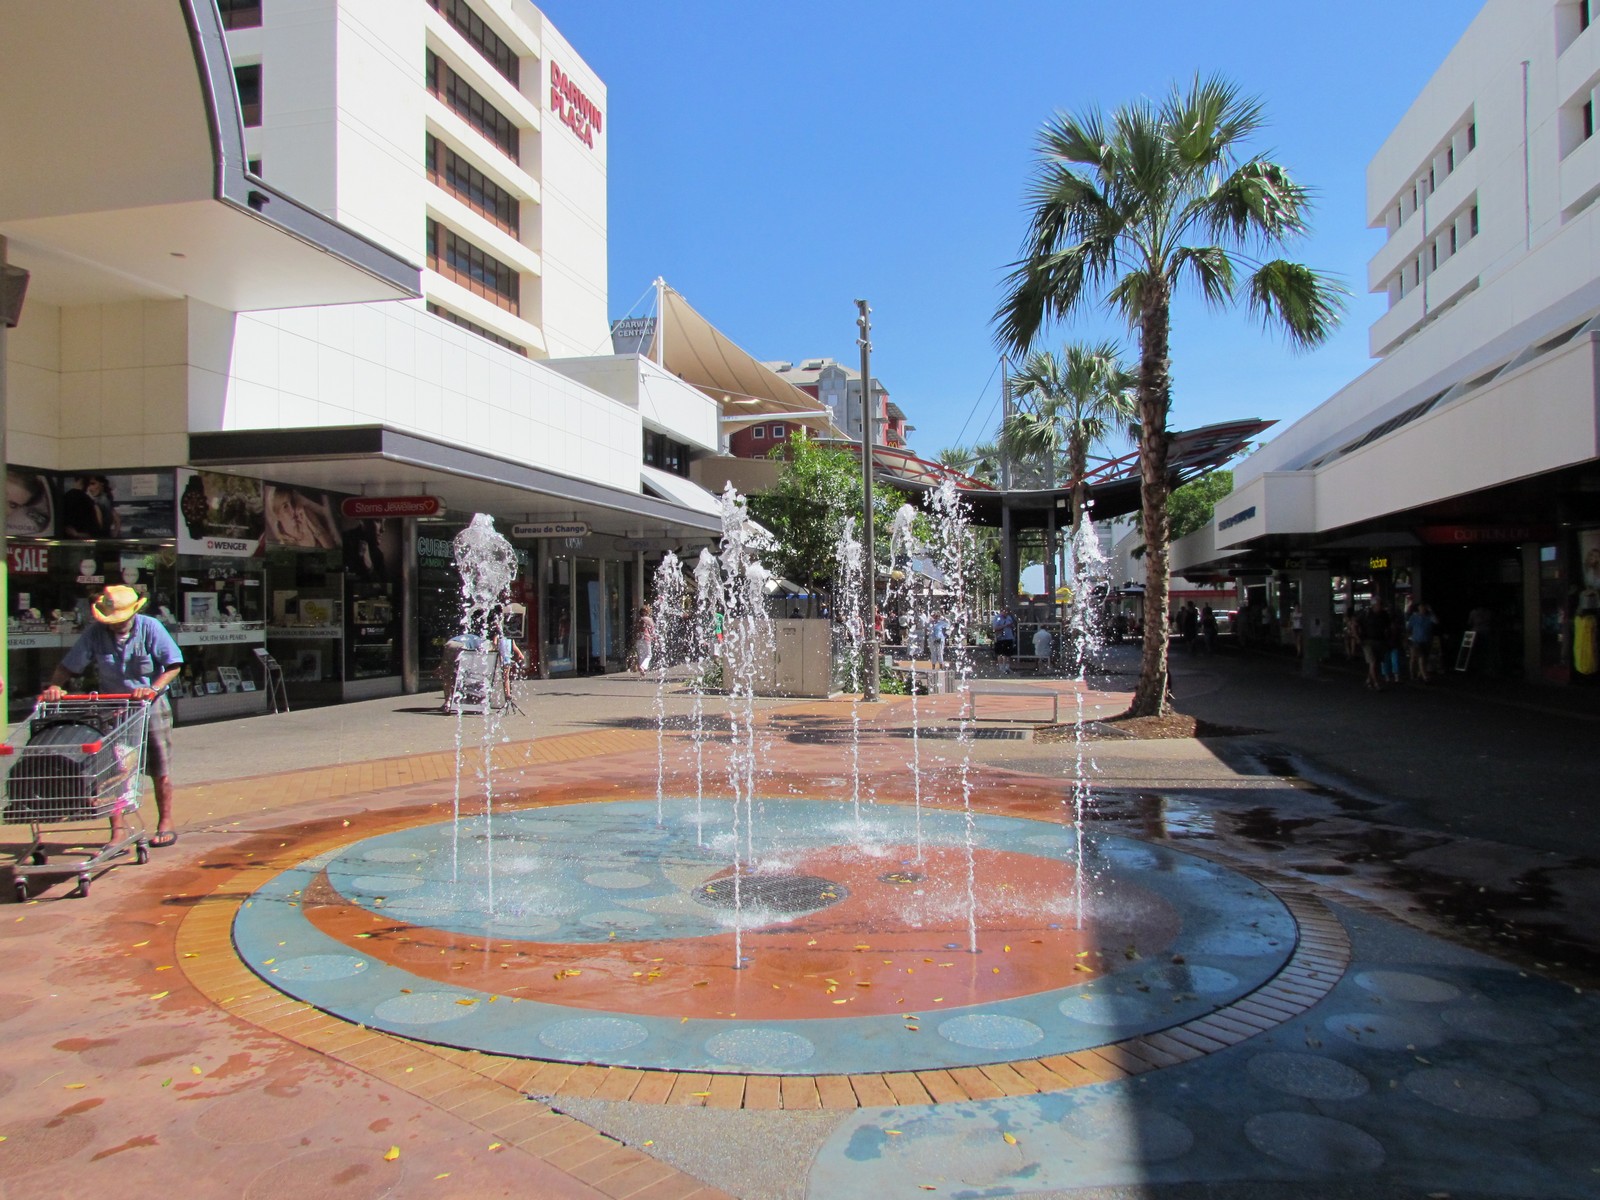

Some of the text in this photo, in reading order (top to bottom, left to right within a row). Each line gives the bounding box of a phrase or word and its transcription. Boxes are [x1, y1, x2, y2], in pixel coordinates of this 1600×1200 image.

[551, 60, 602, 134] DARWIN
[551, 86, 593, 150] PLAZA
[619, 320, 654, 329] DARWIN
[617, 328, 655, 337] CENTRAL
[384, 501, 425, 512] Jewellers
[514, 526, 541, 534] Bureau
[555, 525, 585, 534] Change
[214, 541, 247, 551] WENGER
[417, 537, 456, 558] CURRE
[14, 548, 48, 572] SALE
[420, 558, 444, 567] CAMBIO
